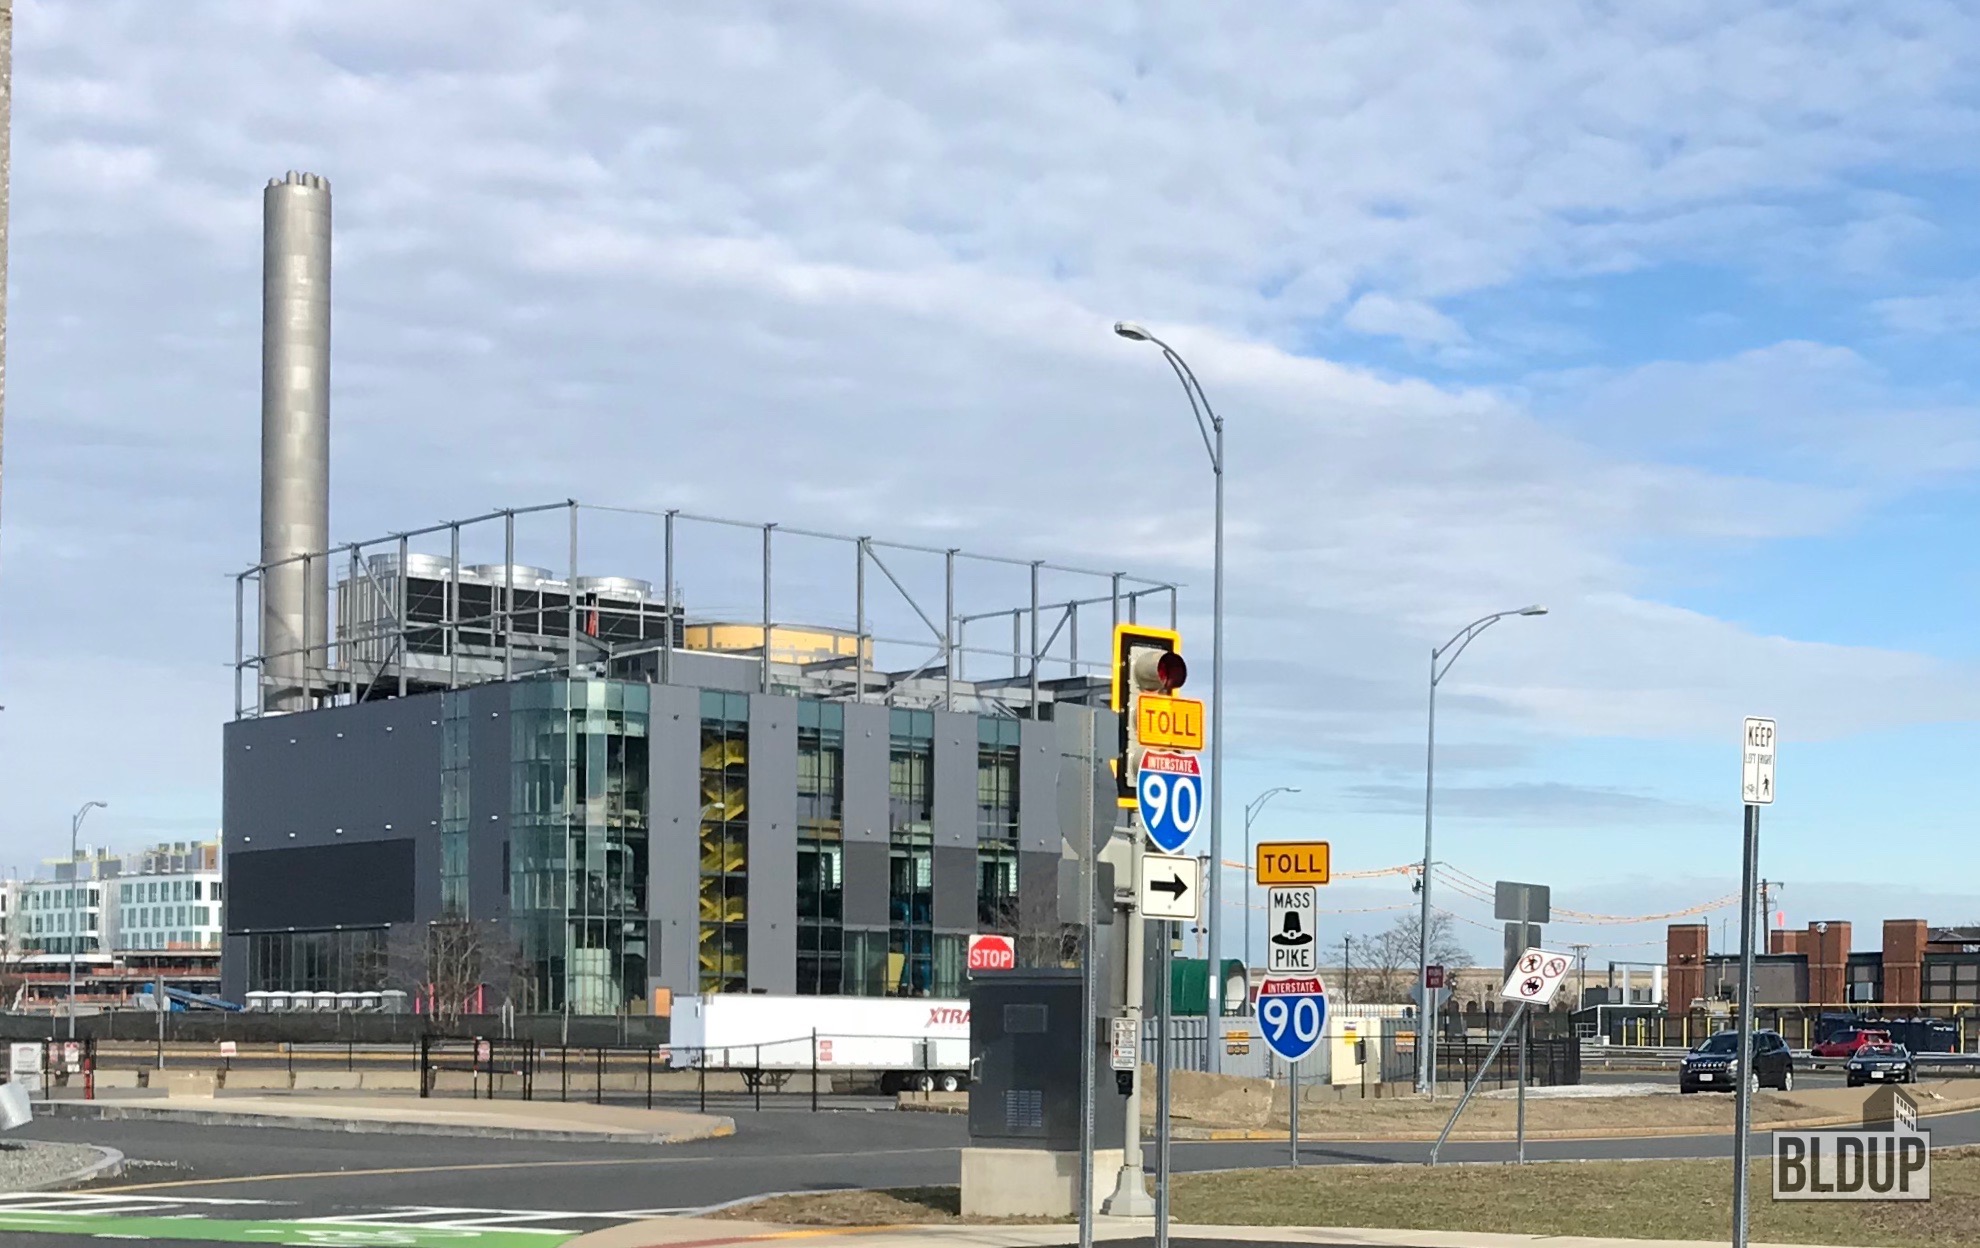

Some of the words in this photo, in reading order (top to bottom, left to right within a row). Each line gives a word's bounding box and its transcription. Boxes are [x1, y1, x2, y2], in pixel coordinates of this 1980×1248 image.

[1145, 709, 1196, 737] TOLL
[1748, 726, 1773, 748] KEEP
[1147, 756, 1194, 773] INTERSTATE
[1143, 774, 1197, 832] 90
[1264, 854, 1322, 873] TOLL
[1274, 892, 1310, 908] MASS
[971, 948, 1011, 968] STOP
[1276, 949, 1309, 967] PIKE
[1267, 982, 1315, 993] INTERSTATE
[1263, 998, 1319, 1042] 90
